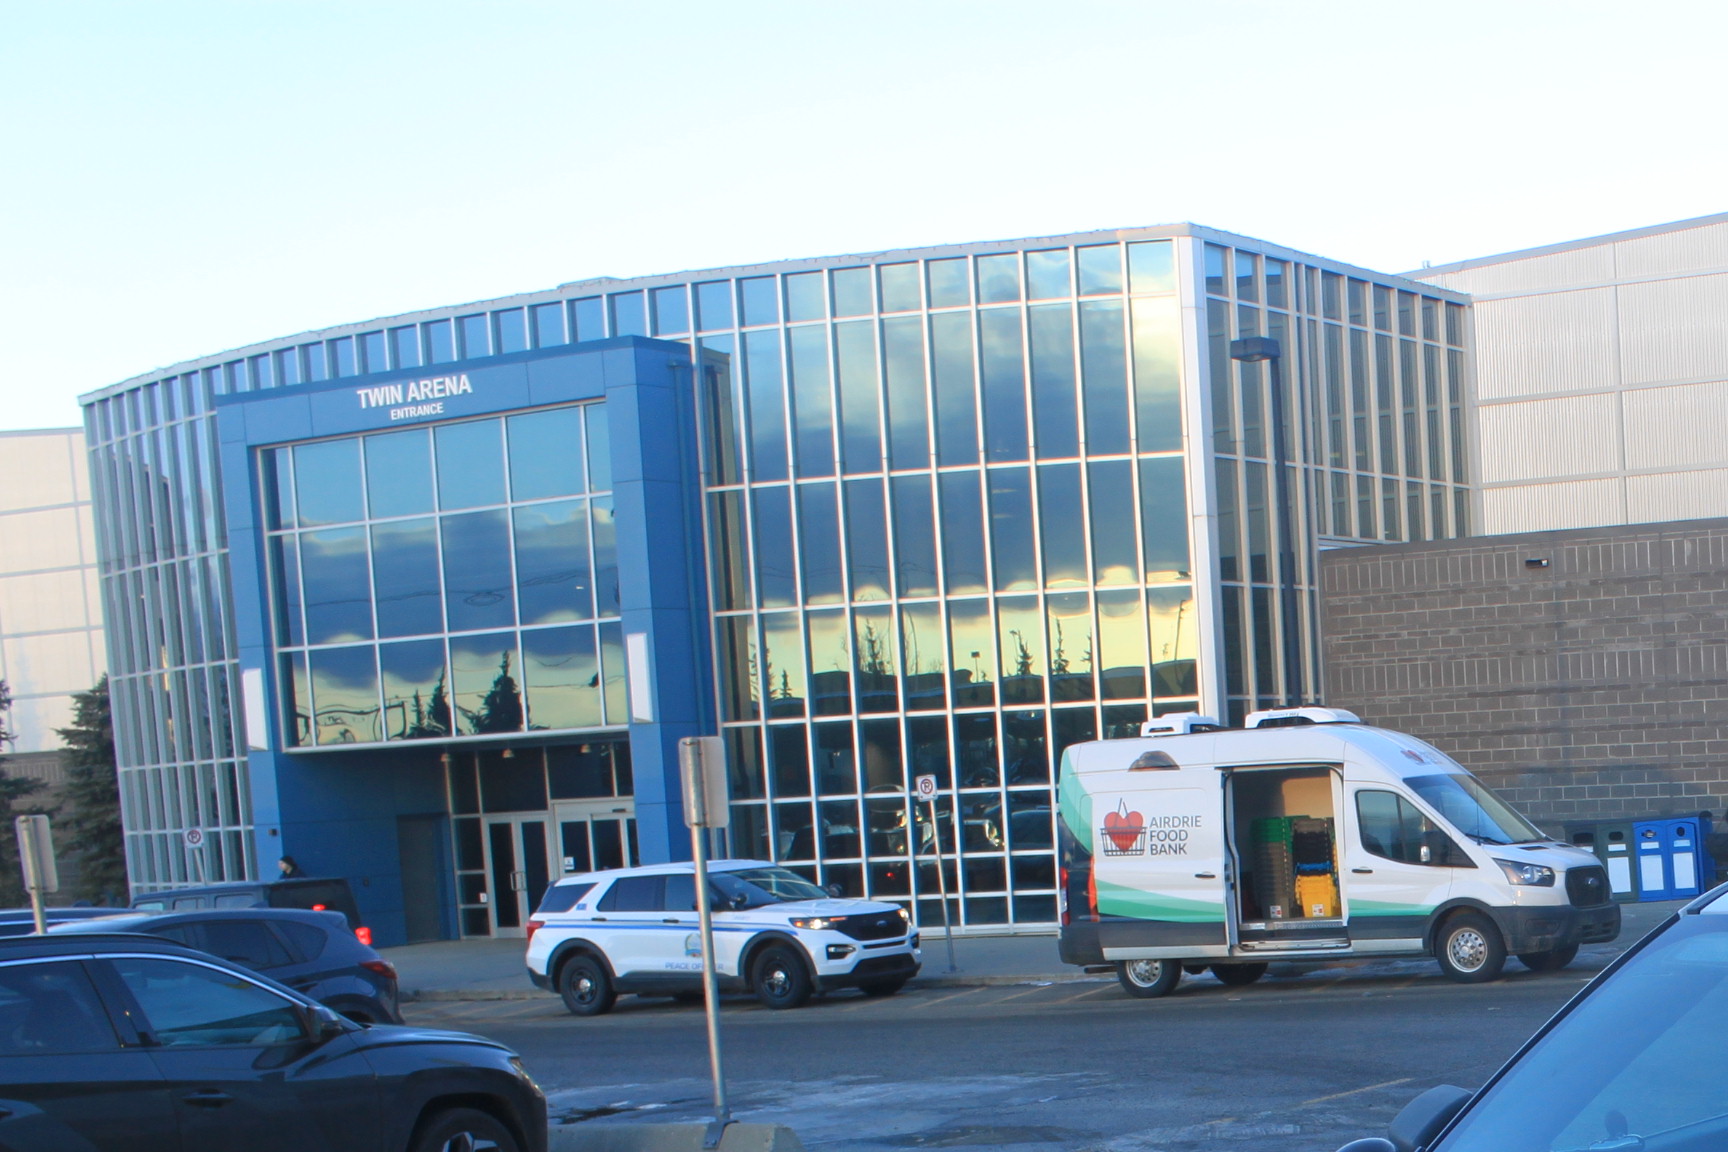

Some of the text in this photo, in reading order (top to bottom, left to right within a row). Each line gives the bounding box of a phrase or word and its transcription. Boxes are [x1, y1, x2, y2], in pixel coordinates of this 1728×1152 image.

[357, 374, 473, 409] TWIN ARENA
[390, 403, 445, 420] ENTRANCE
[1149, 816, 1202, 828] AIRDRIE
[1150, 830, 1188, 842] FOOD
[1150, 843, 1187, 856] BANK
